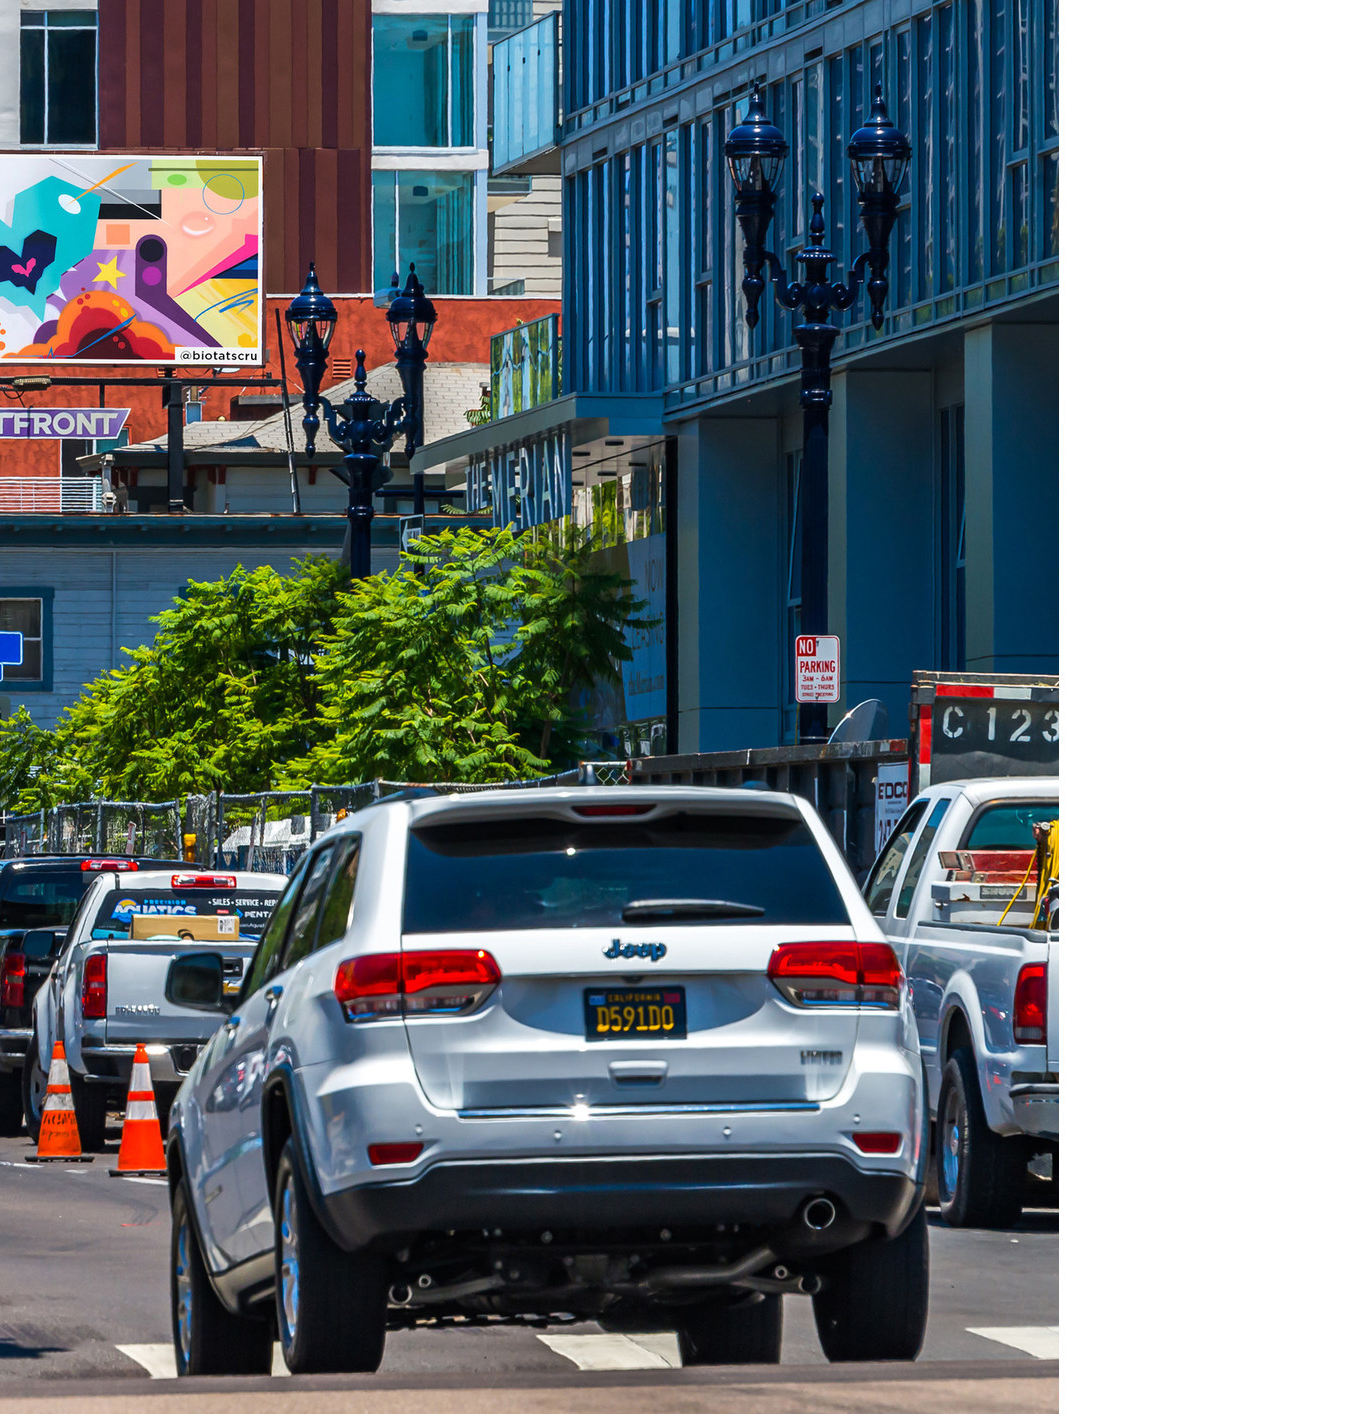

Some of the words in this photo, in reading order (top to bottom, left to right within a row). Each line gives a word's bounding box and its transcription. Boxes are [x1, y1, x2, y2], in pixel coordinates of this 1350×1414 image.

[180, 350, 258, 361] @biotatscru
[799, 639, 814, 654] NO
[799, 660, 836, 673] PARKING
[942, 706, 964, 739] C
[211, 898, 230, 906] SALES
[235, 898, 259, 906] SERVICE
[264, 899, 278, 907] REP
[111, 904, 197, 916] AQUATICS
[603, 938, 668, 962] Jeep
[607, 993, 661, 1002] CALIFORNIA
